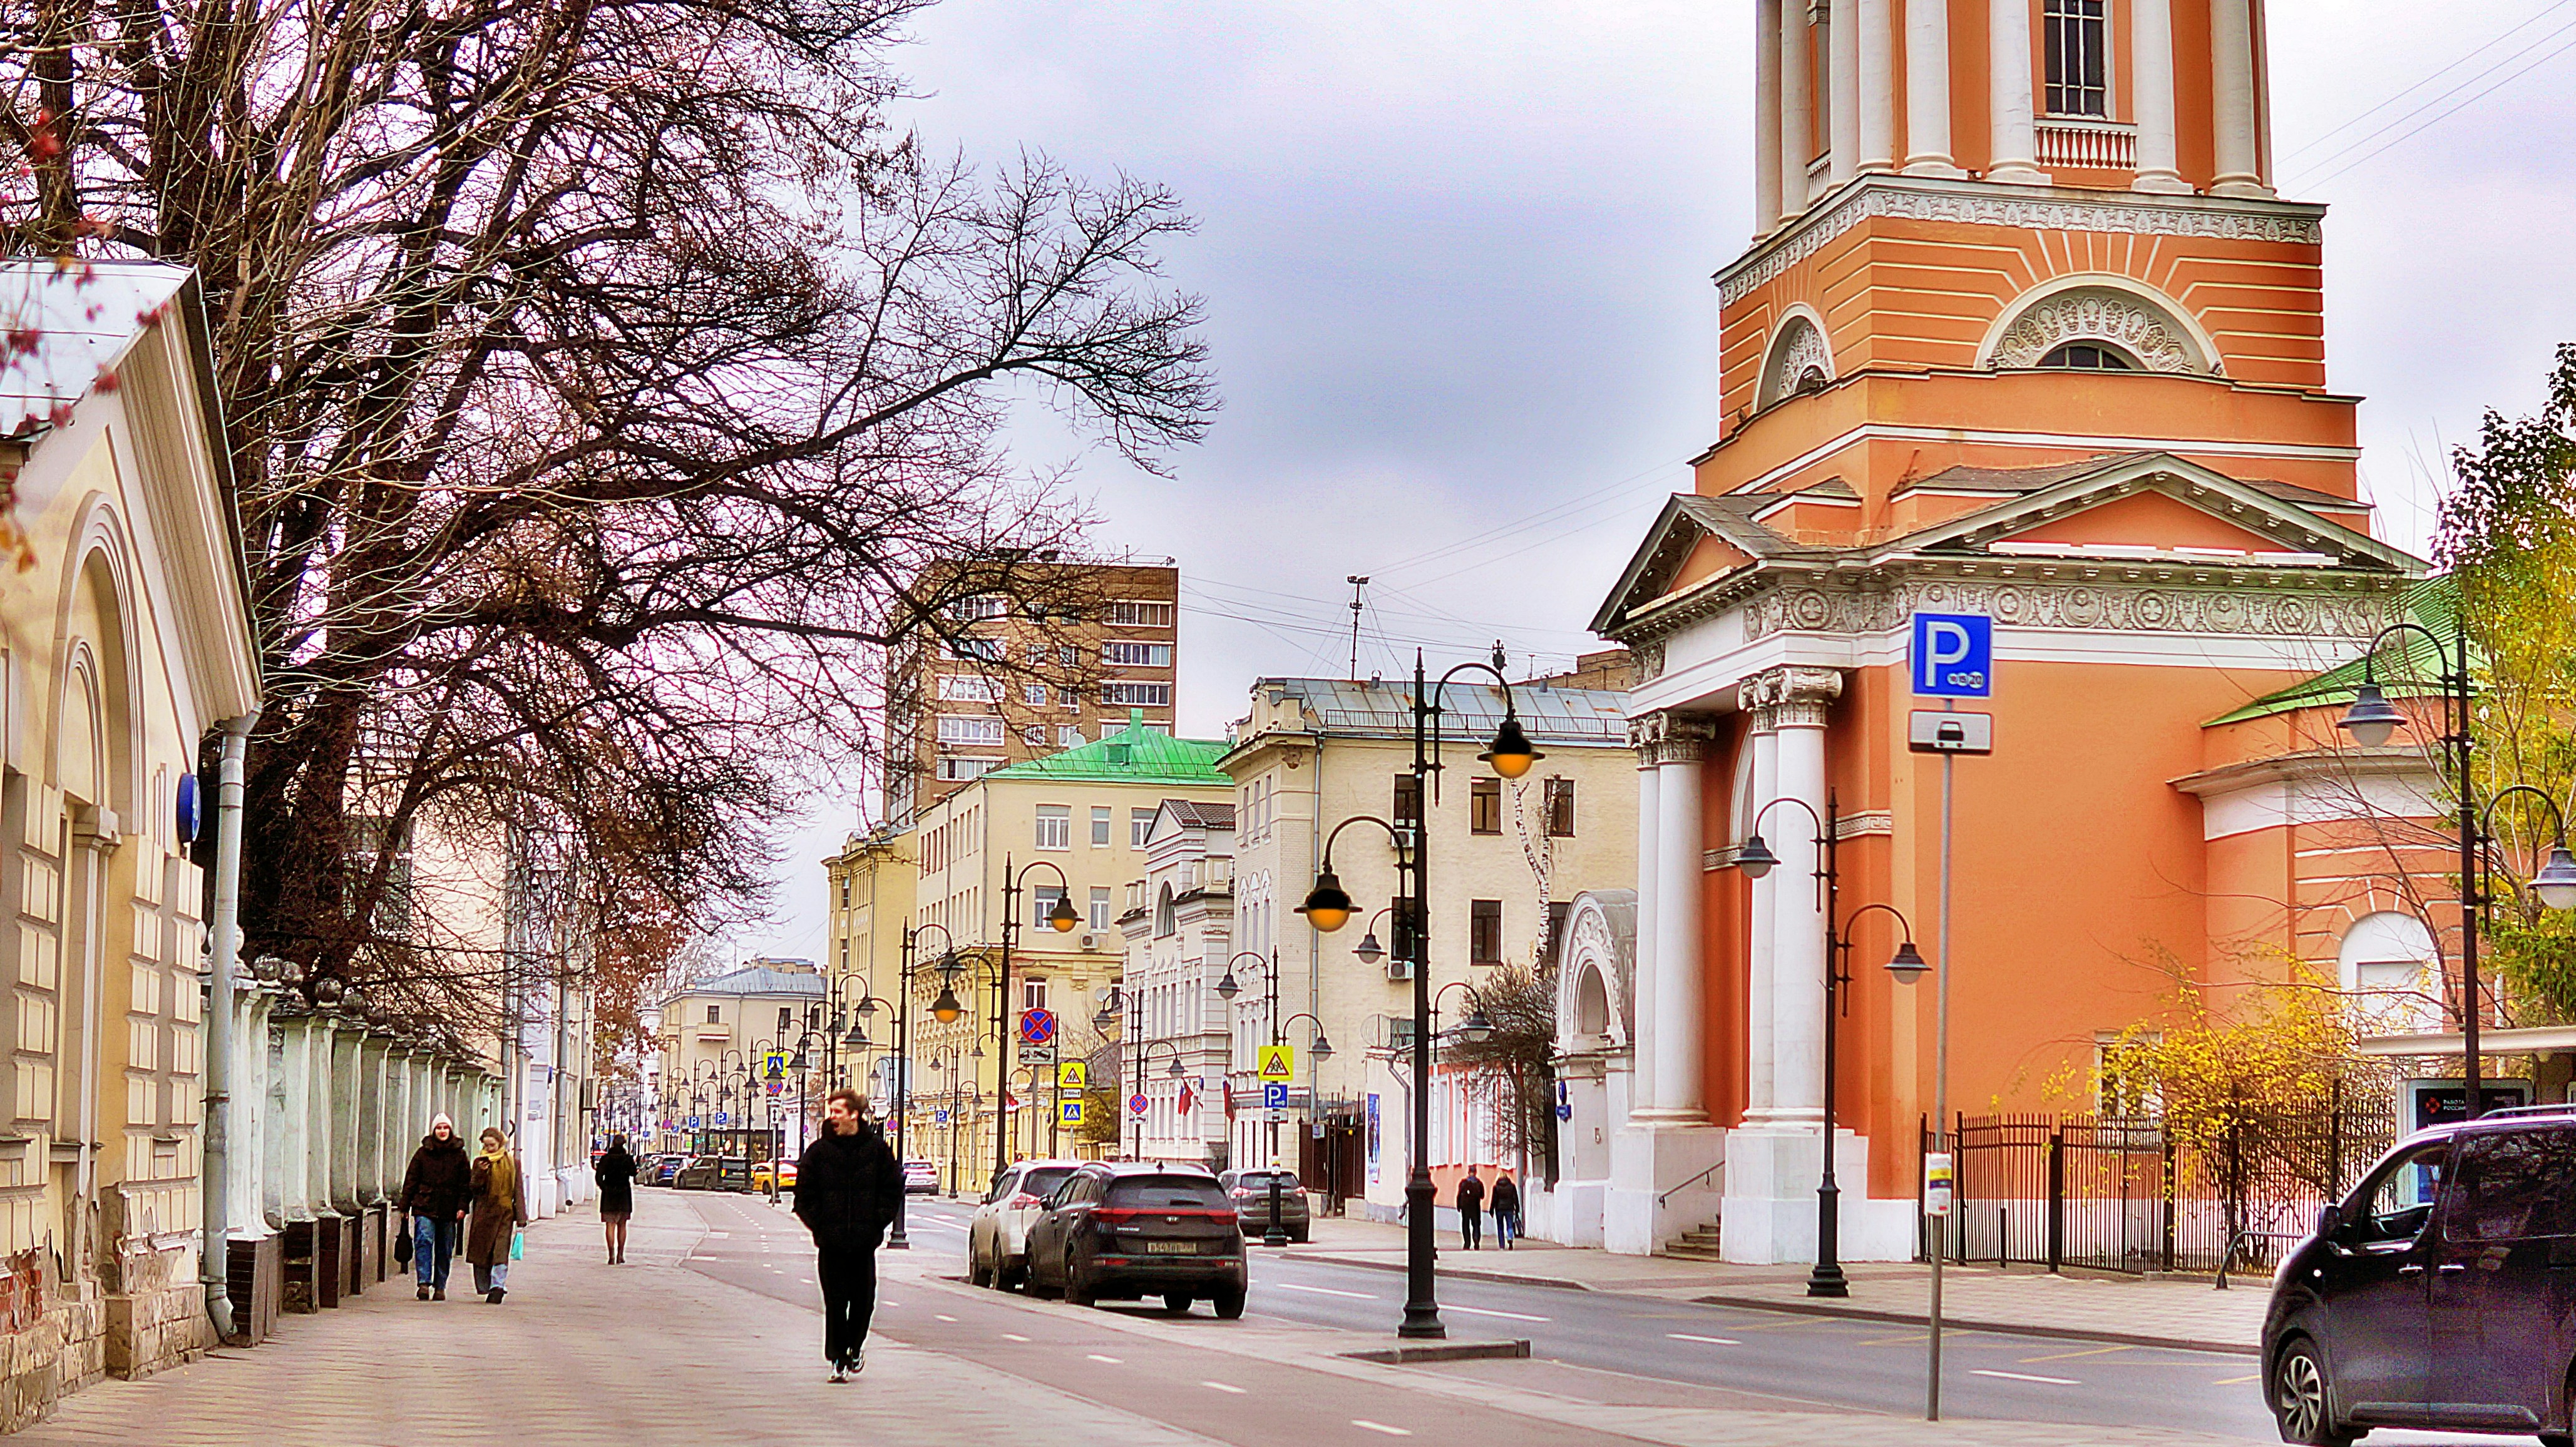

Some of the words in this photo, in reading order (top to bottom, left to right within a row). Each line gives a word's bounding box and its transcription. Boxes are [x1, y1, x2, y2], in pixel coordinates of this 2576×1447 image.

[1925, 620, 1971, 687] P
[1969, 675, 1982, 685] 20
[1268, 1087, 1281, 1106] P
[717, 1113, 724, 1123] P
[937, 1112, 944, 1122] P
[691, 1118, 697, 1127] P
